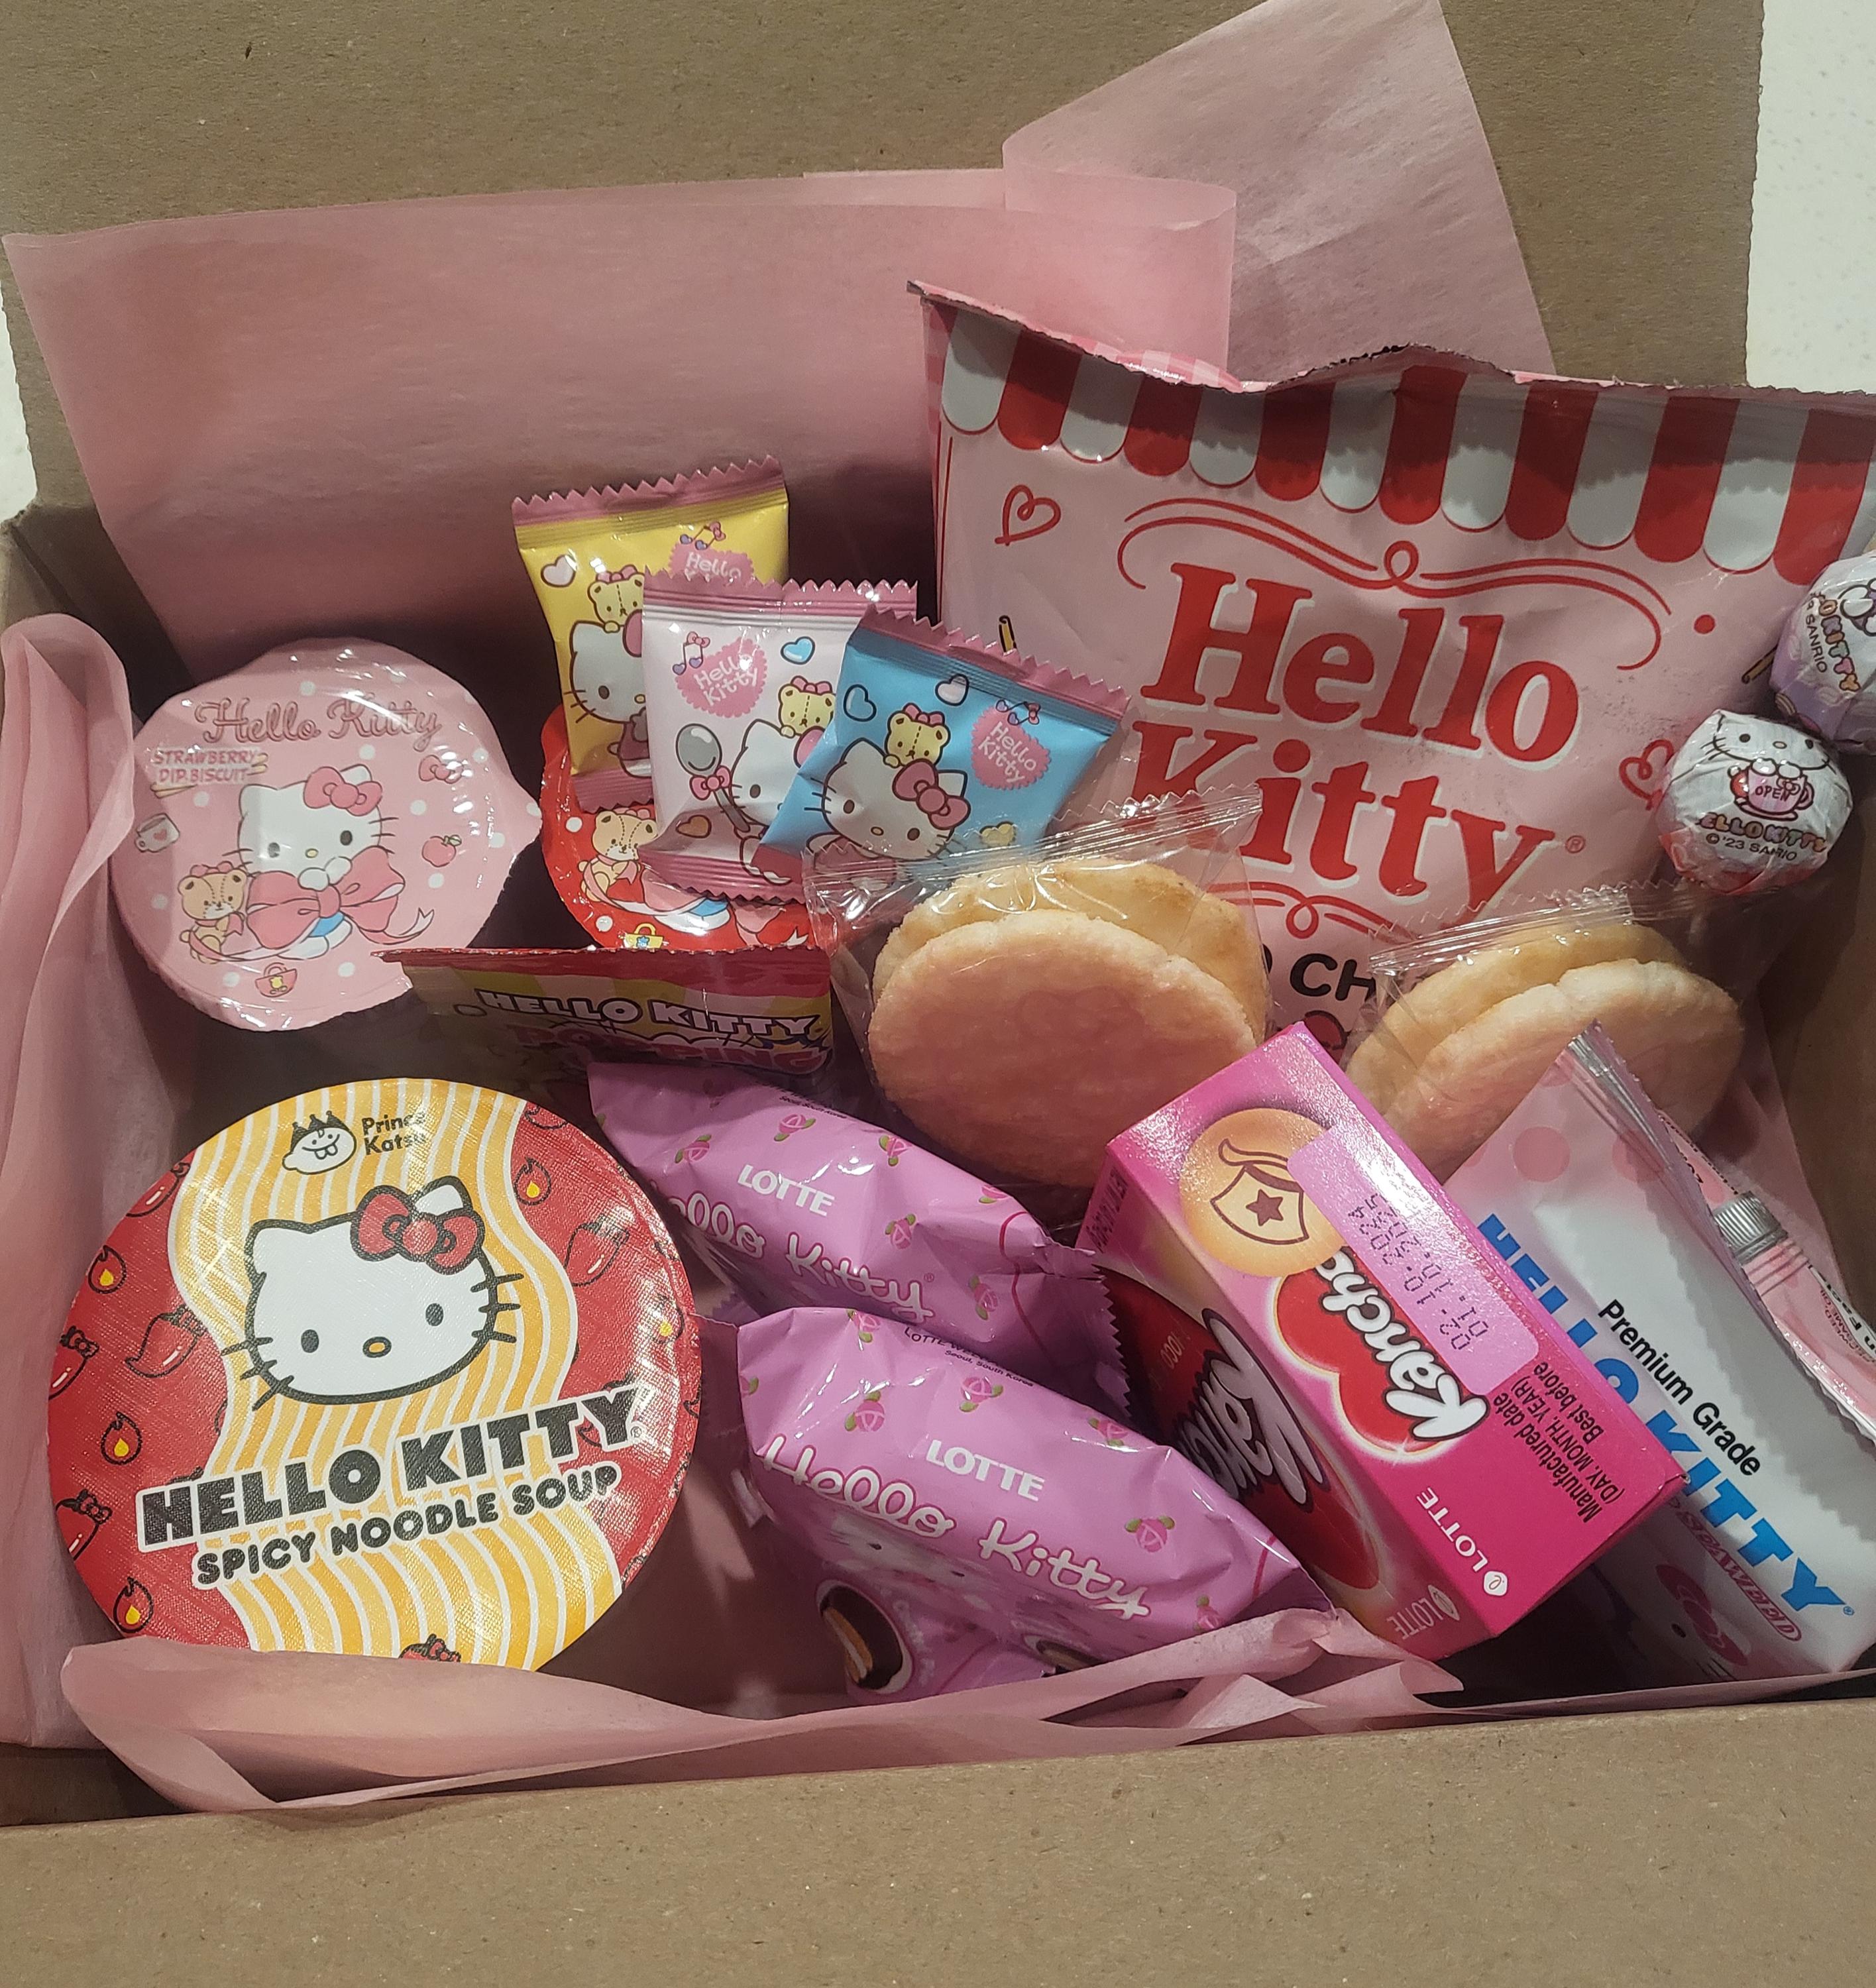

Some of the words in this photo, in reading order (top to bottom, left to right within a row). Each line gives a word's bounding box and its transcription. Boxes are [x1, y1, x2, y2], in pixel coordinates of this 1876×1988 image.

[1139, 561, 1581, 765] Hello
[1806, 614, 1828, 673] SANRIO
[693, 653, 753, 690] Hell
[703, 667, 758, 706] Kitty
[194, 696, 321, 744] Hello
[327, 693, 443, 752] Kitty
[990, 720, 1037, 772] Hello
[153, 749, 257, 764] STRAWBERRY
[977, 734, 1025, 784] Kitty
[1755, 785, 1791, 802] OPEN
[1128, 720, 1557, 929] Kitty
[1698, 812, 1764, 839] ELLO
[1749, 843, 1798, 861] SANRIO
[474, 989, 643, 1024] HELLO
[651, 997, 822, 1035] KITTY
[737, 1163, 836, 1217] LOTTE
[669, 1190, 767, 1260] llo
[785, 1231, 935, 1324] Kitty
[976, 1360, 1004, 1376] South
[1316, 1249, 1489, 1441] Kancho
[1492, 1392, 1525, 1427] date
[1510, 1375, 1551, 1424] YEAR)
[1533, 1361, 1578, 1413] before
[1598, 1299, 1694, 1406] Premium
[1692, 1402, 1761, 1477] Grade
[1566, 1404, 1605, 1445] Best
[140, 1448, 383, 1547] HELLO
[400, 1388, 636, 1494] KITTY
[925, 1439, 1046, 1503] LOTTE
[1513, 1422, 1604, 1523] Manufactured
[197, 1529, 315, 1586] SPICY
[330, 1493, 499, 1557] NOODLE
[513, 1463, 620, 1516] SOUP
[763, 1434, 954, 1539] Hello
[977, 1517, 1152, 1622] Kitty
[1415, 1486, 1487, 1571] LOTTE
[1645, 1409, 1847, 1612] KITTY
[1388, 1596, 1443, 1640] LOTTE
